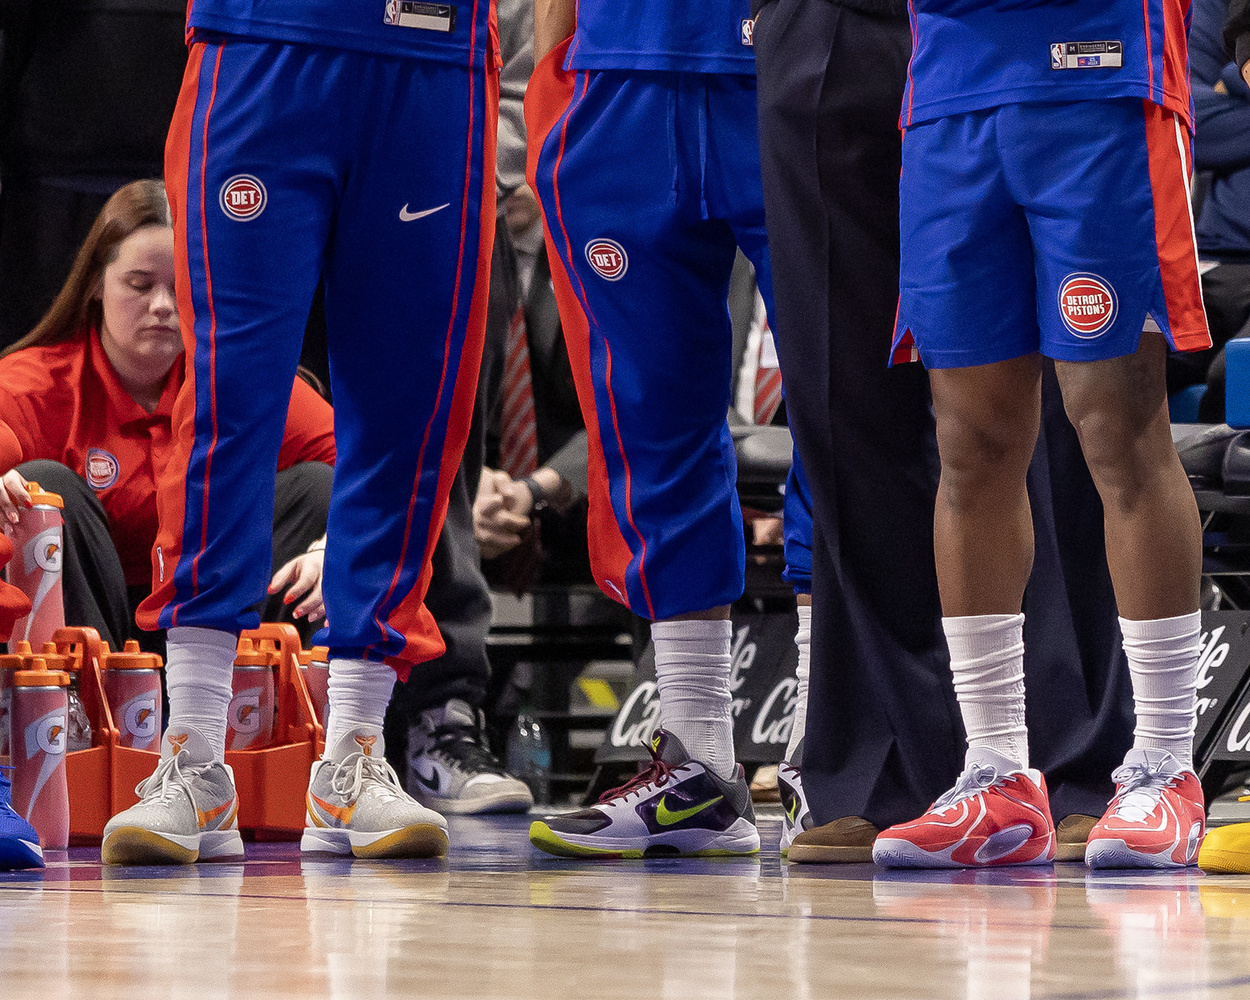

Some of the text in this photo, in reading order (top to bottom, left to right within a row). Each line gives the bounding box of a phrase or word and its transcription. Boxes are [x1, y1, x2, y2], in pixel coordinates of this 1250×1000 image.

[230, 190, 256, 206] DET
[593, 253, 617, 267] DET
[1066, 293, 1103, 306] DETROIT
[1067, 303, 1106, 316] PISTONS
[33, 534, 63, 573] G
[124, 699, 156, 739] G
[228, 696, 260, 735] G
[36, 715, 66, 755] G
